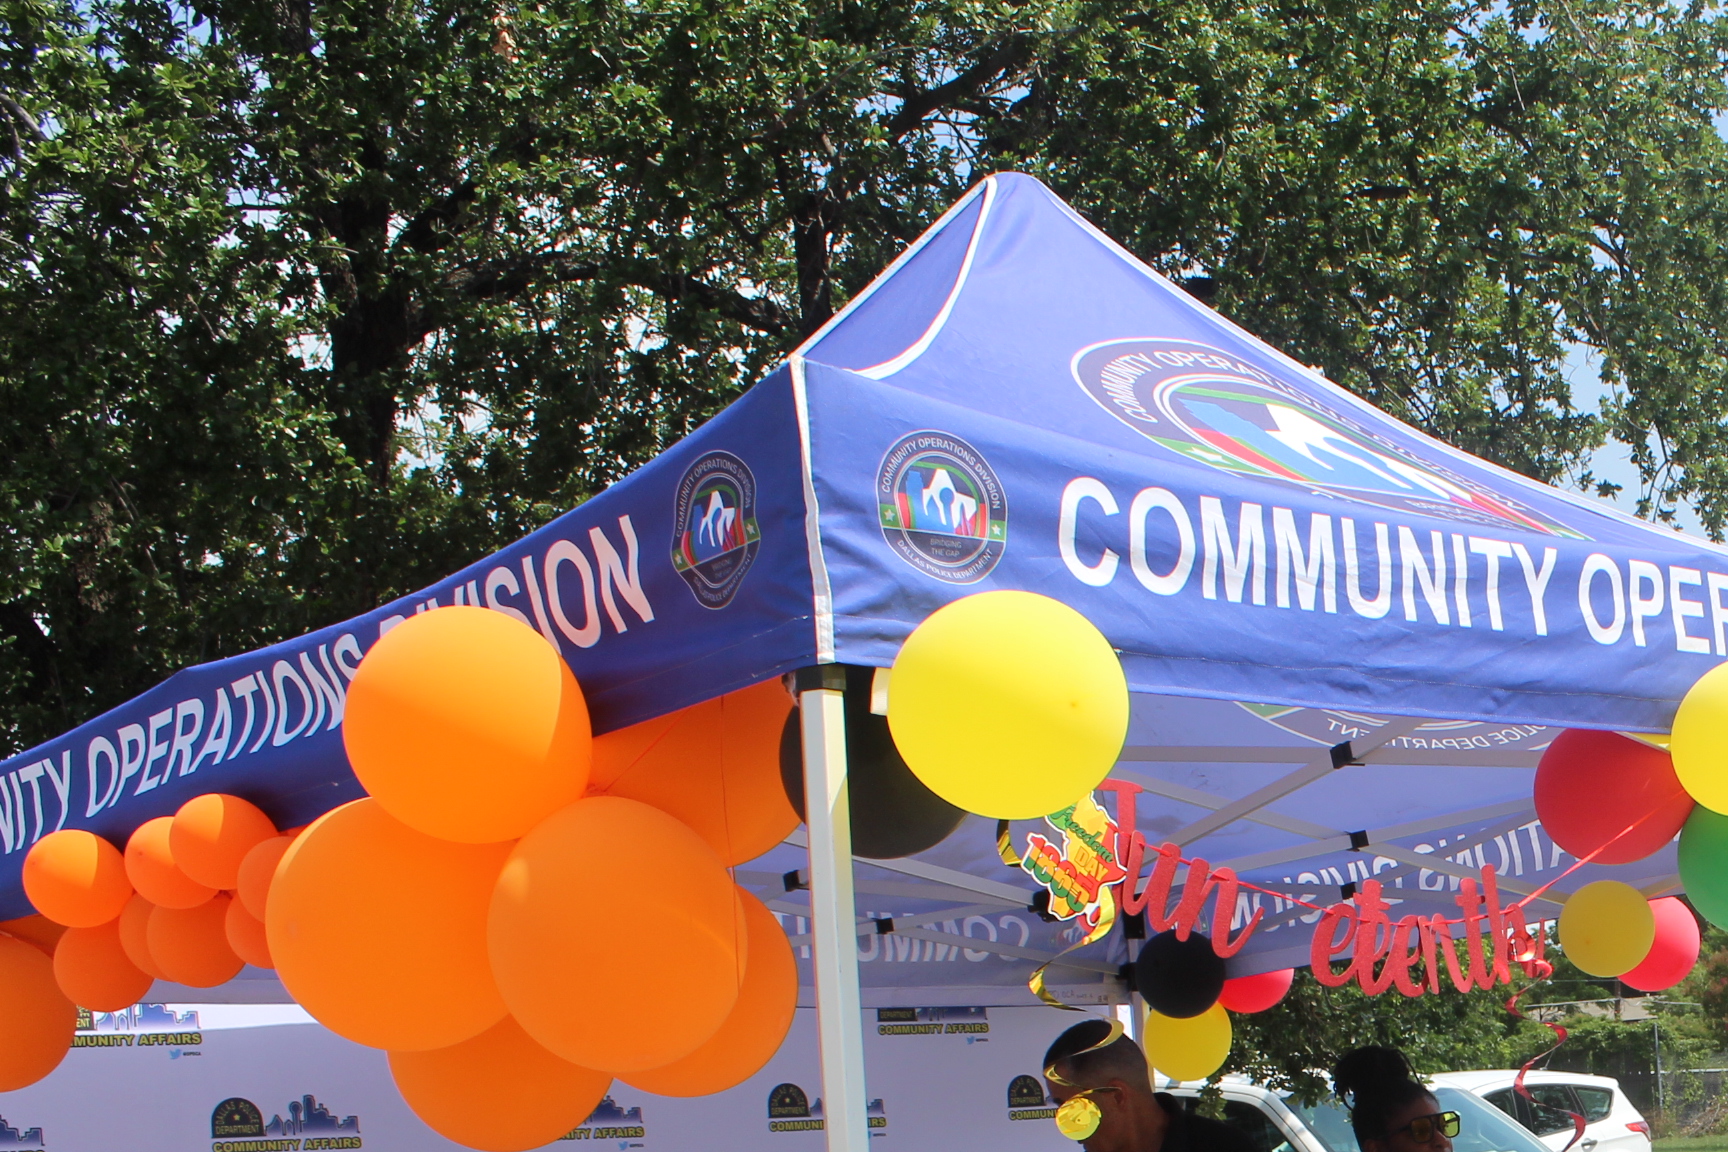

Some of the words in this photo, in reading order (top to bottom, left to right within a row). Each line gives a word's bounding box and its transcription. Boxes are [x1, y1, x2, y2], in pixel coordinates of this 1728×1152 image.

[1100, 353, 1160, 424] COMMUNITY
[882, 440, 917, 493] COMMUNITY
[918, 437, 977, 466] OPERATIONS
[974, 463, 1001, 509] DIVISION
[676, 473, 694, 537] COMMUNITY
[694, 458, 737, 477] OPERATIONS
[897, 539, 926, 570] DALLAS
[953, 548, 993, 580] DEPARTMENT
[1058, 477, 1557, 637] COMMUNITY
[1022, 836, 1090, 912] 1865
[1074, 845, 1108, 882] DAY
[71, 1034, 134, 1047] MUNITY
[138, 1032, 202, 1046] AFFAIRS
[877, 1024, 944, 1036] COMMUNITY
[945, 1022, 990, 1034] AFFAIRS
[215, 1101, 235, 1125] DALLAS
[238, 1100, 259, 1124] POLICE
[769, 1119, 824, 1132] COMMUNI
[215, 1124, 259, 1135] DEPARTMENT
[303, 1137, 362, 1150] AFFAIRS
[593, 1126, 645, 1140] AFFAIRS
